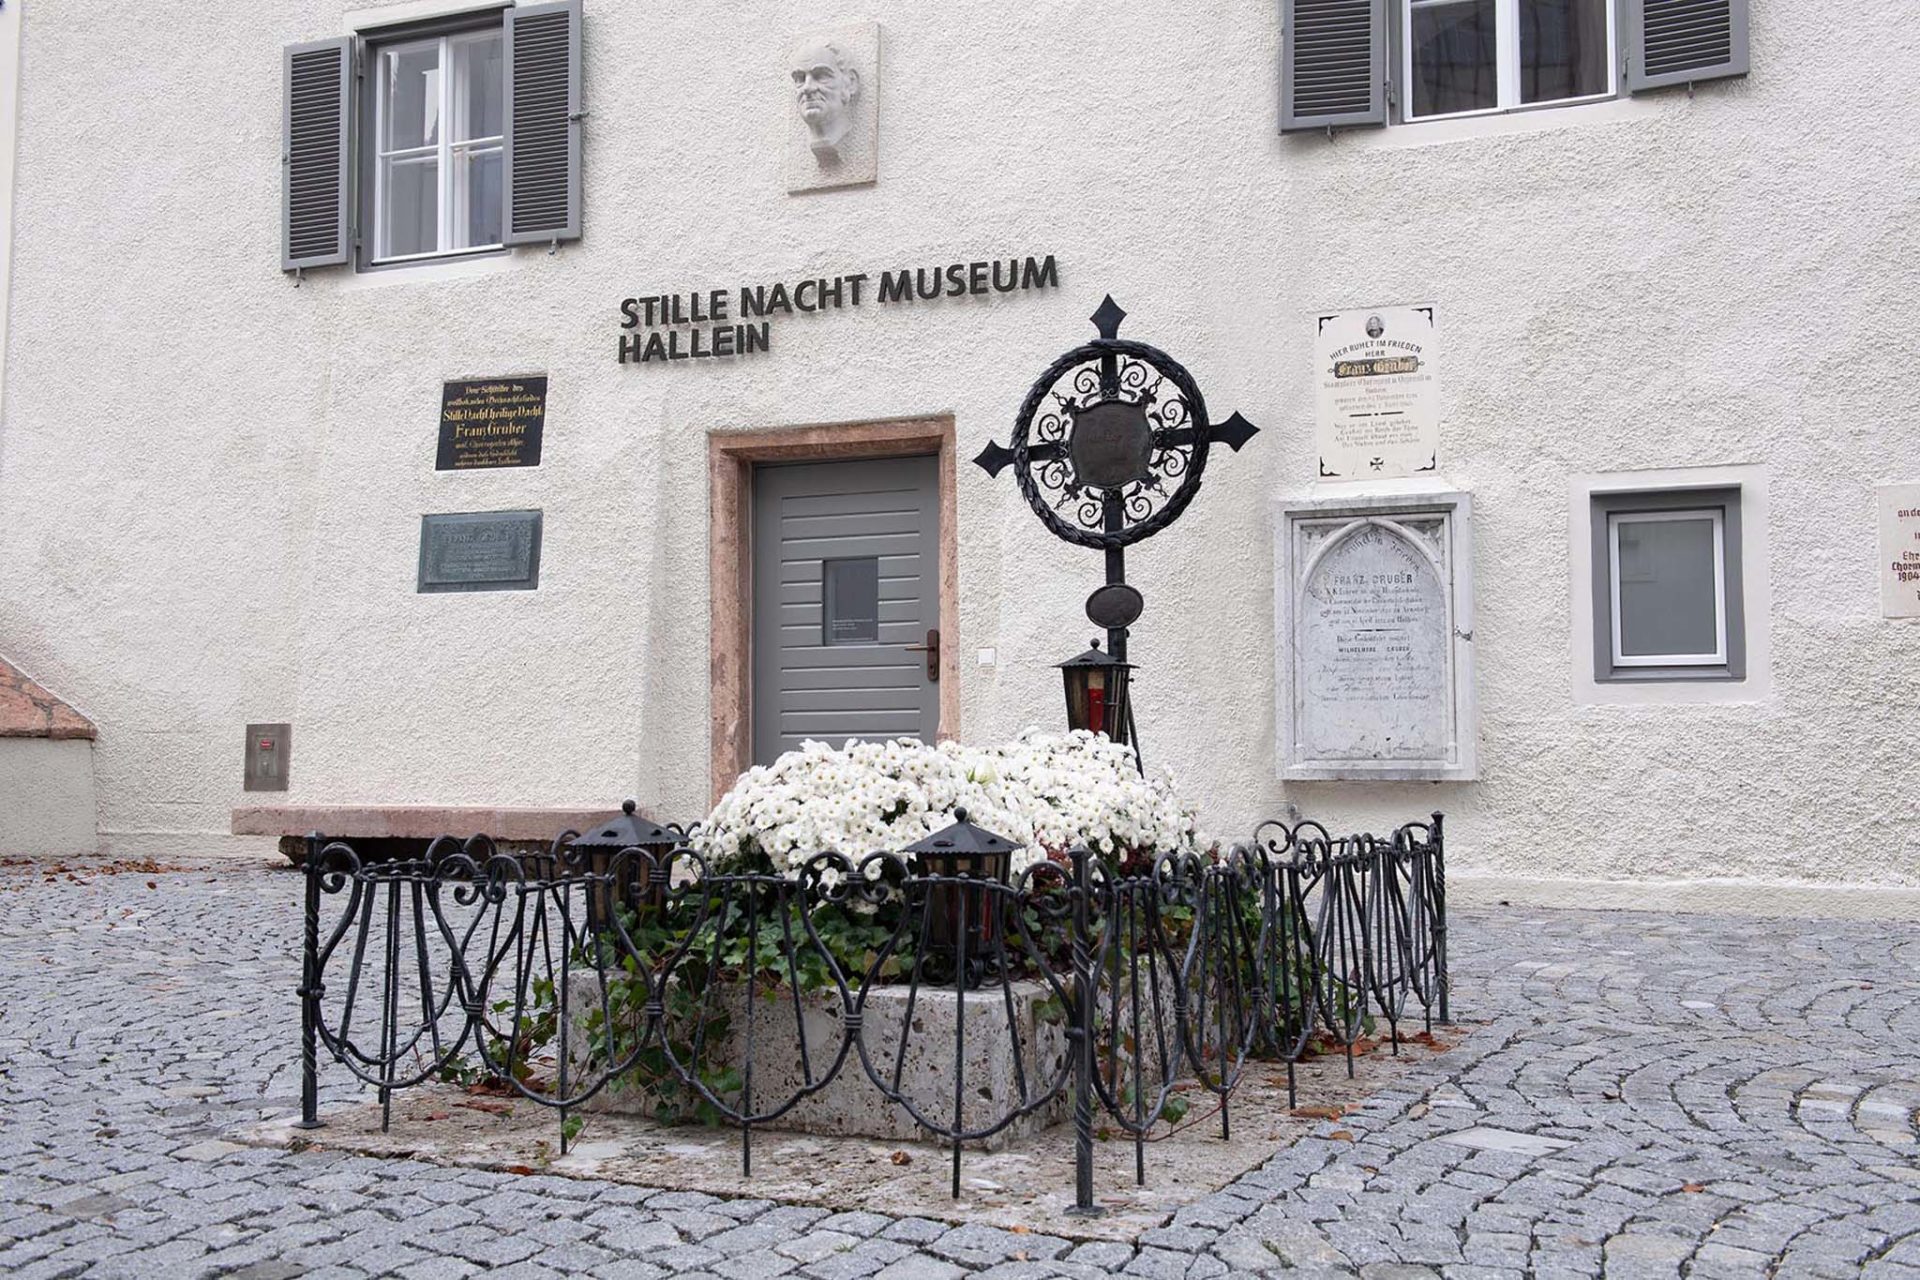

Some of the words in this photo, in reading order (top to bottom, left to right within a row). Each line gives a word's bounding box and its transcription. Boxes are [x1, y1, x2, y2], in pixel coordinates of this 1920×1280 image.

[620, 290, 728, 329] STILLE
[740, 274, 868, 318] NACHT
[877, 255, 1058, 303] MUSEUM
[619, 322, 770, 364] HALLEIN
[1329, 347, 1349, 360] HIER
[1349, 340, 1374, 352] RUHET
[1376, 339, 1386, 348] IM
[1387, 340, 1422, 354] FRIEDEN
[1365, 350, 1386, 358] HERR
[455, 424, 486, 439] Franz
[487, 420, 527, 436] Gruber
